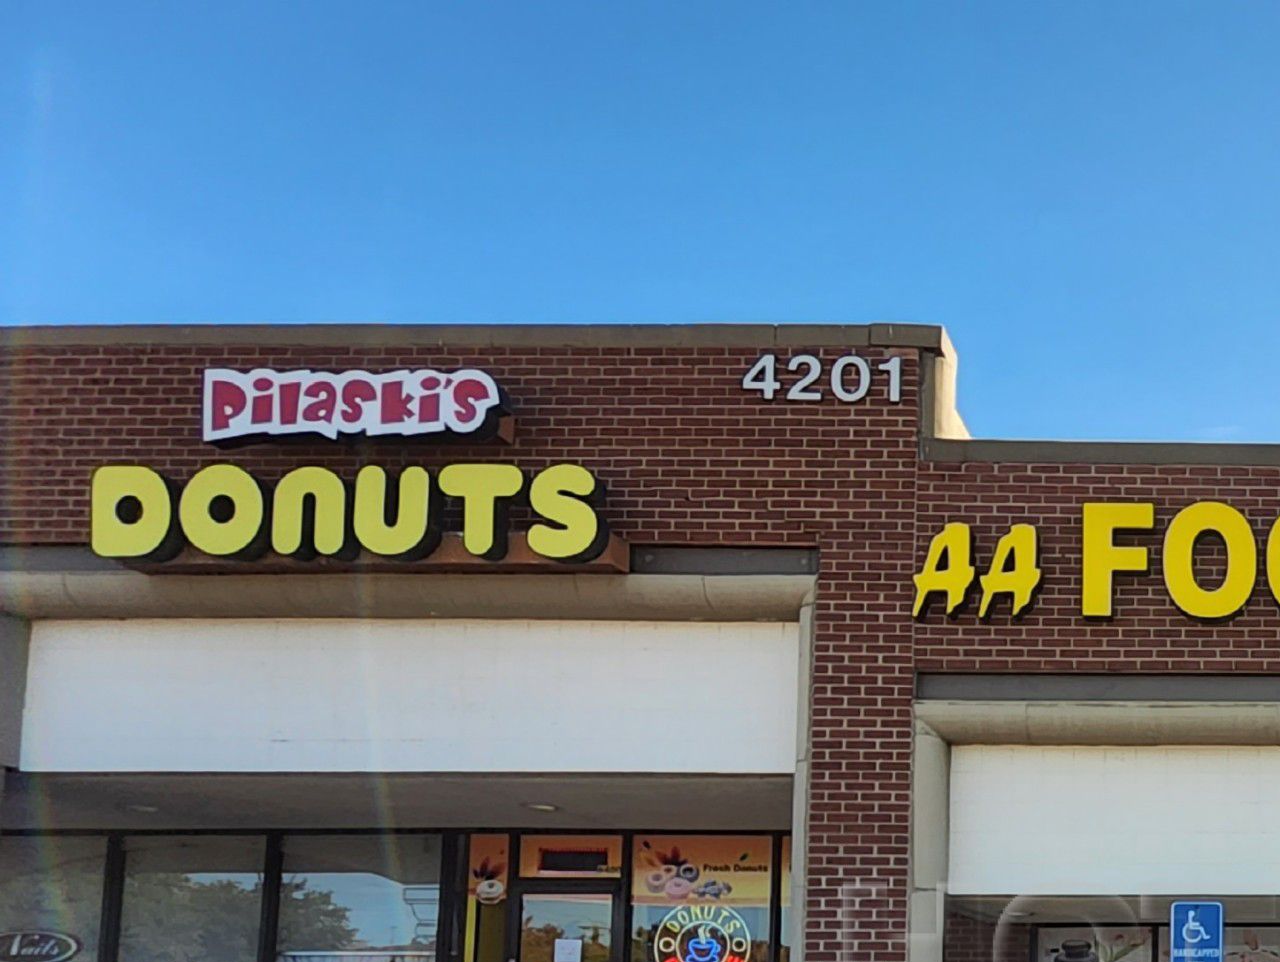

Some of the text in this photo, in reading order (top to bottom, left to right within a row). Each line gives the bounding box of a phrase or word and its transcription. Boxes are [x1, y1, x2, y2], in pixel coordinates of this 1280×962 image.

[742, 354, 901, 402] 4201
[92, 463, 598, 558] DONUTS
[912, 522, 1042, 619] AA
[703, 864, 769, 872] Fresh Donuts
[667, 902, 741, 933] DONUTS
